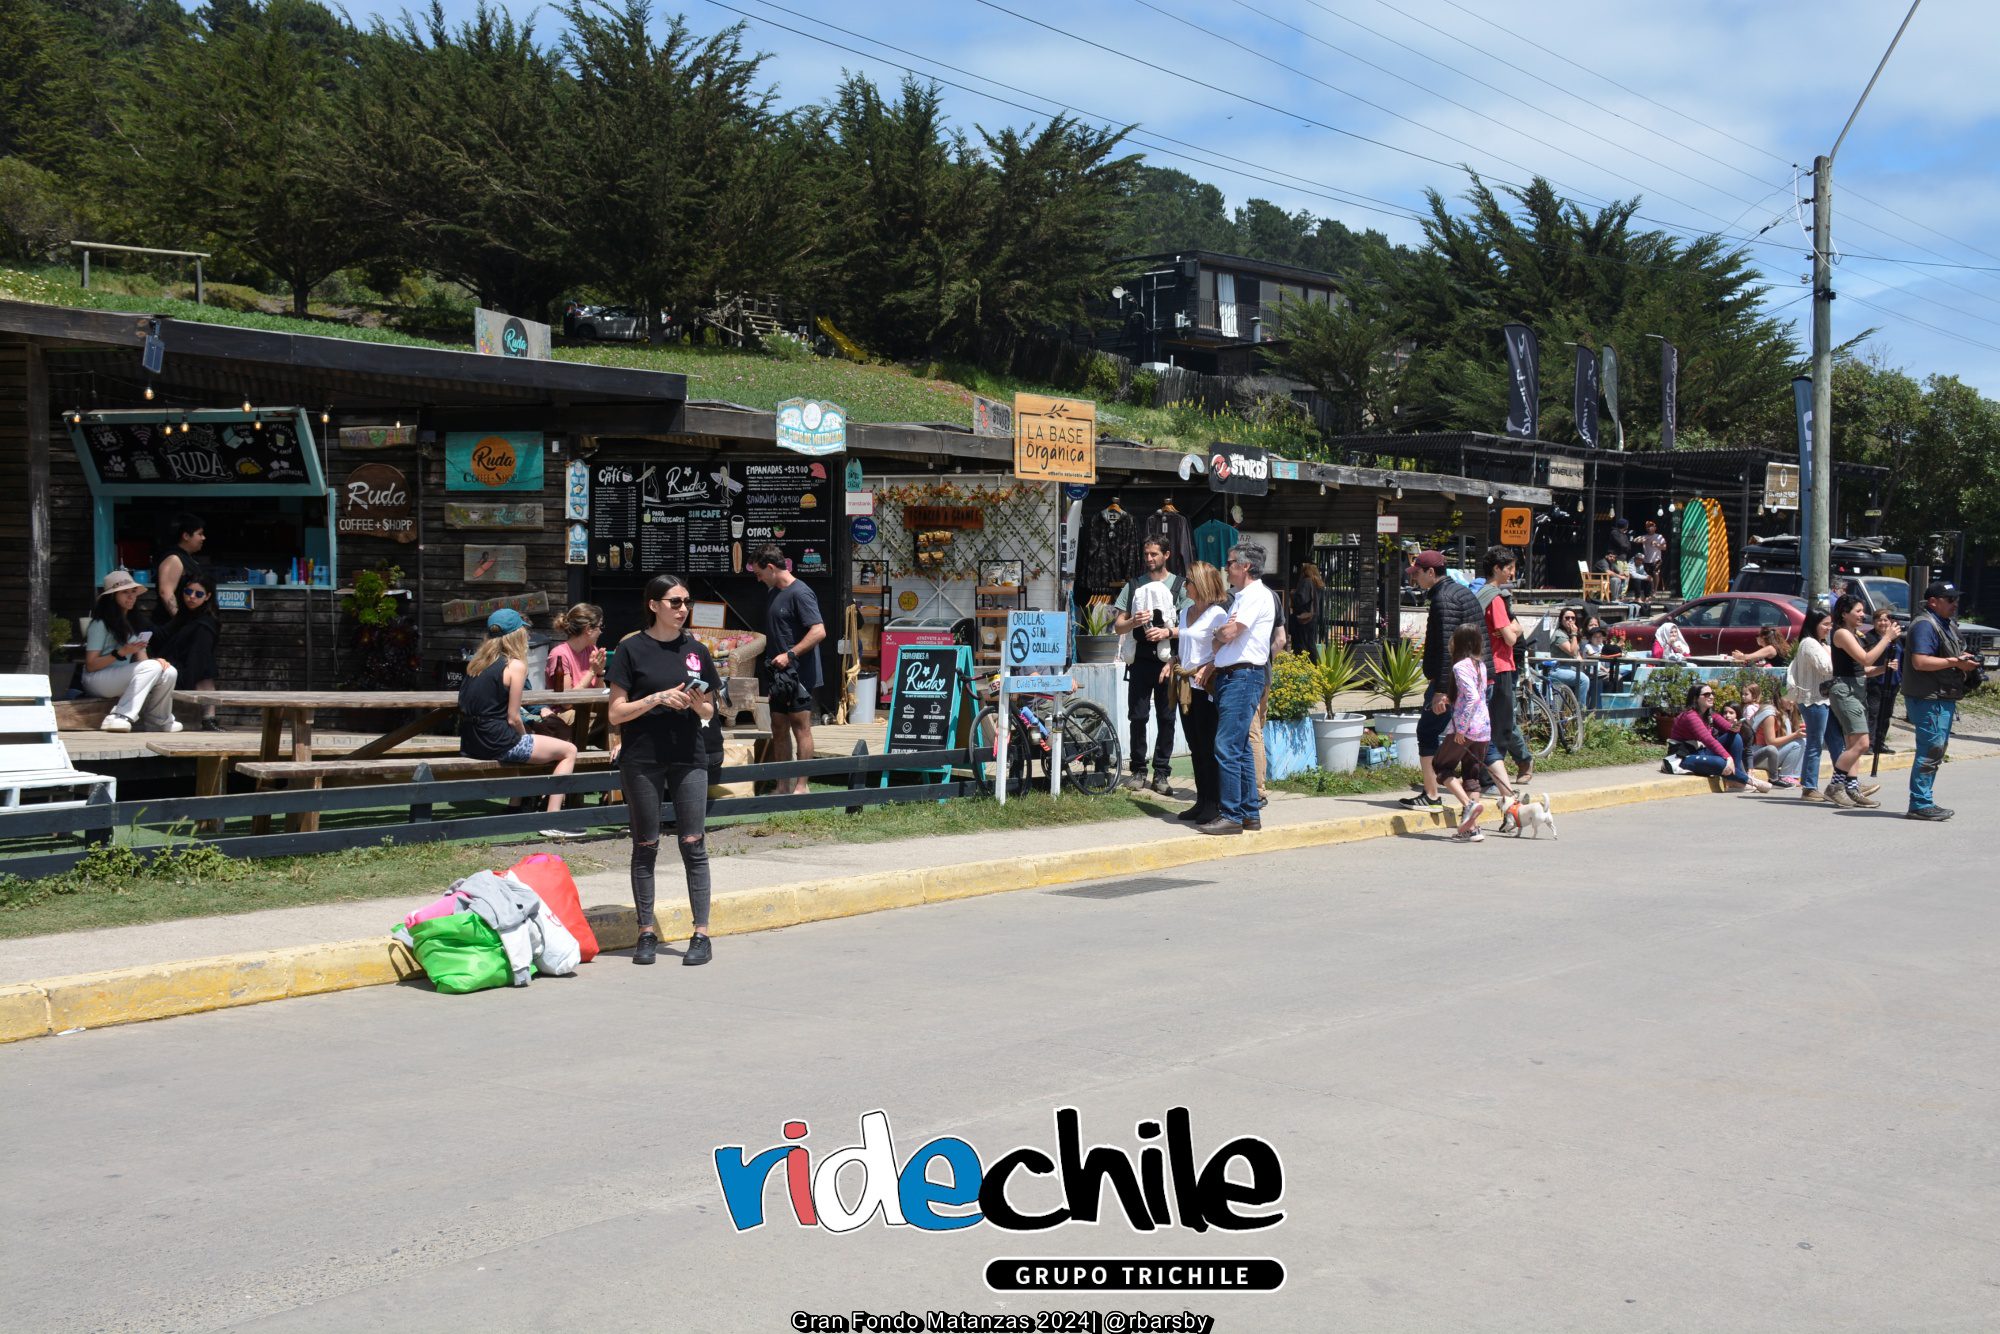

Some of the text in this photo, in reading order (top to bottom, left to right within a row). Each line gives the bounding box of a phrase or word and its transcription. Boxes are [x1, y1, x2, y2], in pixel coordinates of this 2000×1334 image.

[505, 328, 527, 353] Ruda
[1027, 423, 1084, 445] LA BASE
[167, 452, 228, 478] RUDA
[472, 445, 515, 472] Ruda
[746, 465, 783, 475] EMPANADAS
[1230, 457, 1268, 480] STOKED
[665, 466, 708, 496] Ruda
[347, 481, 406, 511] Ruda
[746, 492, 778, 505] SANDWICH
[651, 515, 686, 524] REFRESCARSE
[688, 510, 698, 518] SIN
[339, 519, 374, 531] COFFEE
[746, 527, 772, 538] OTROS
[696, 543, 730, 553] ADEMÁS
[217, 591, 246, 601] PEDIDO
[1012, 612, 1046, 626] ORILLAS
[1031, 626, 1047, 638] SIN
[1032, 643, 1060, 654] COLILLAS
[905, 661, 943, 691] Ruda
